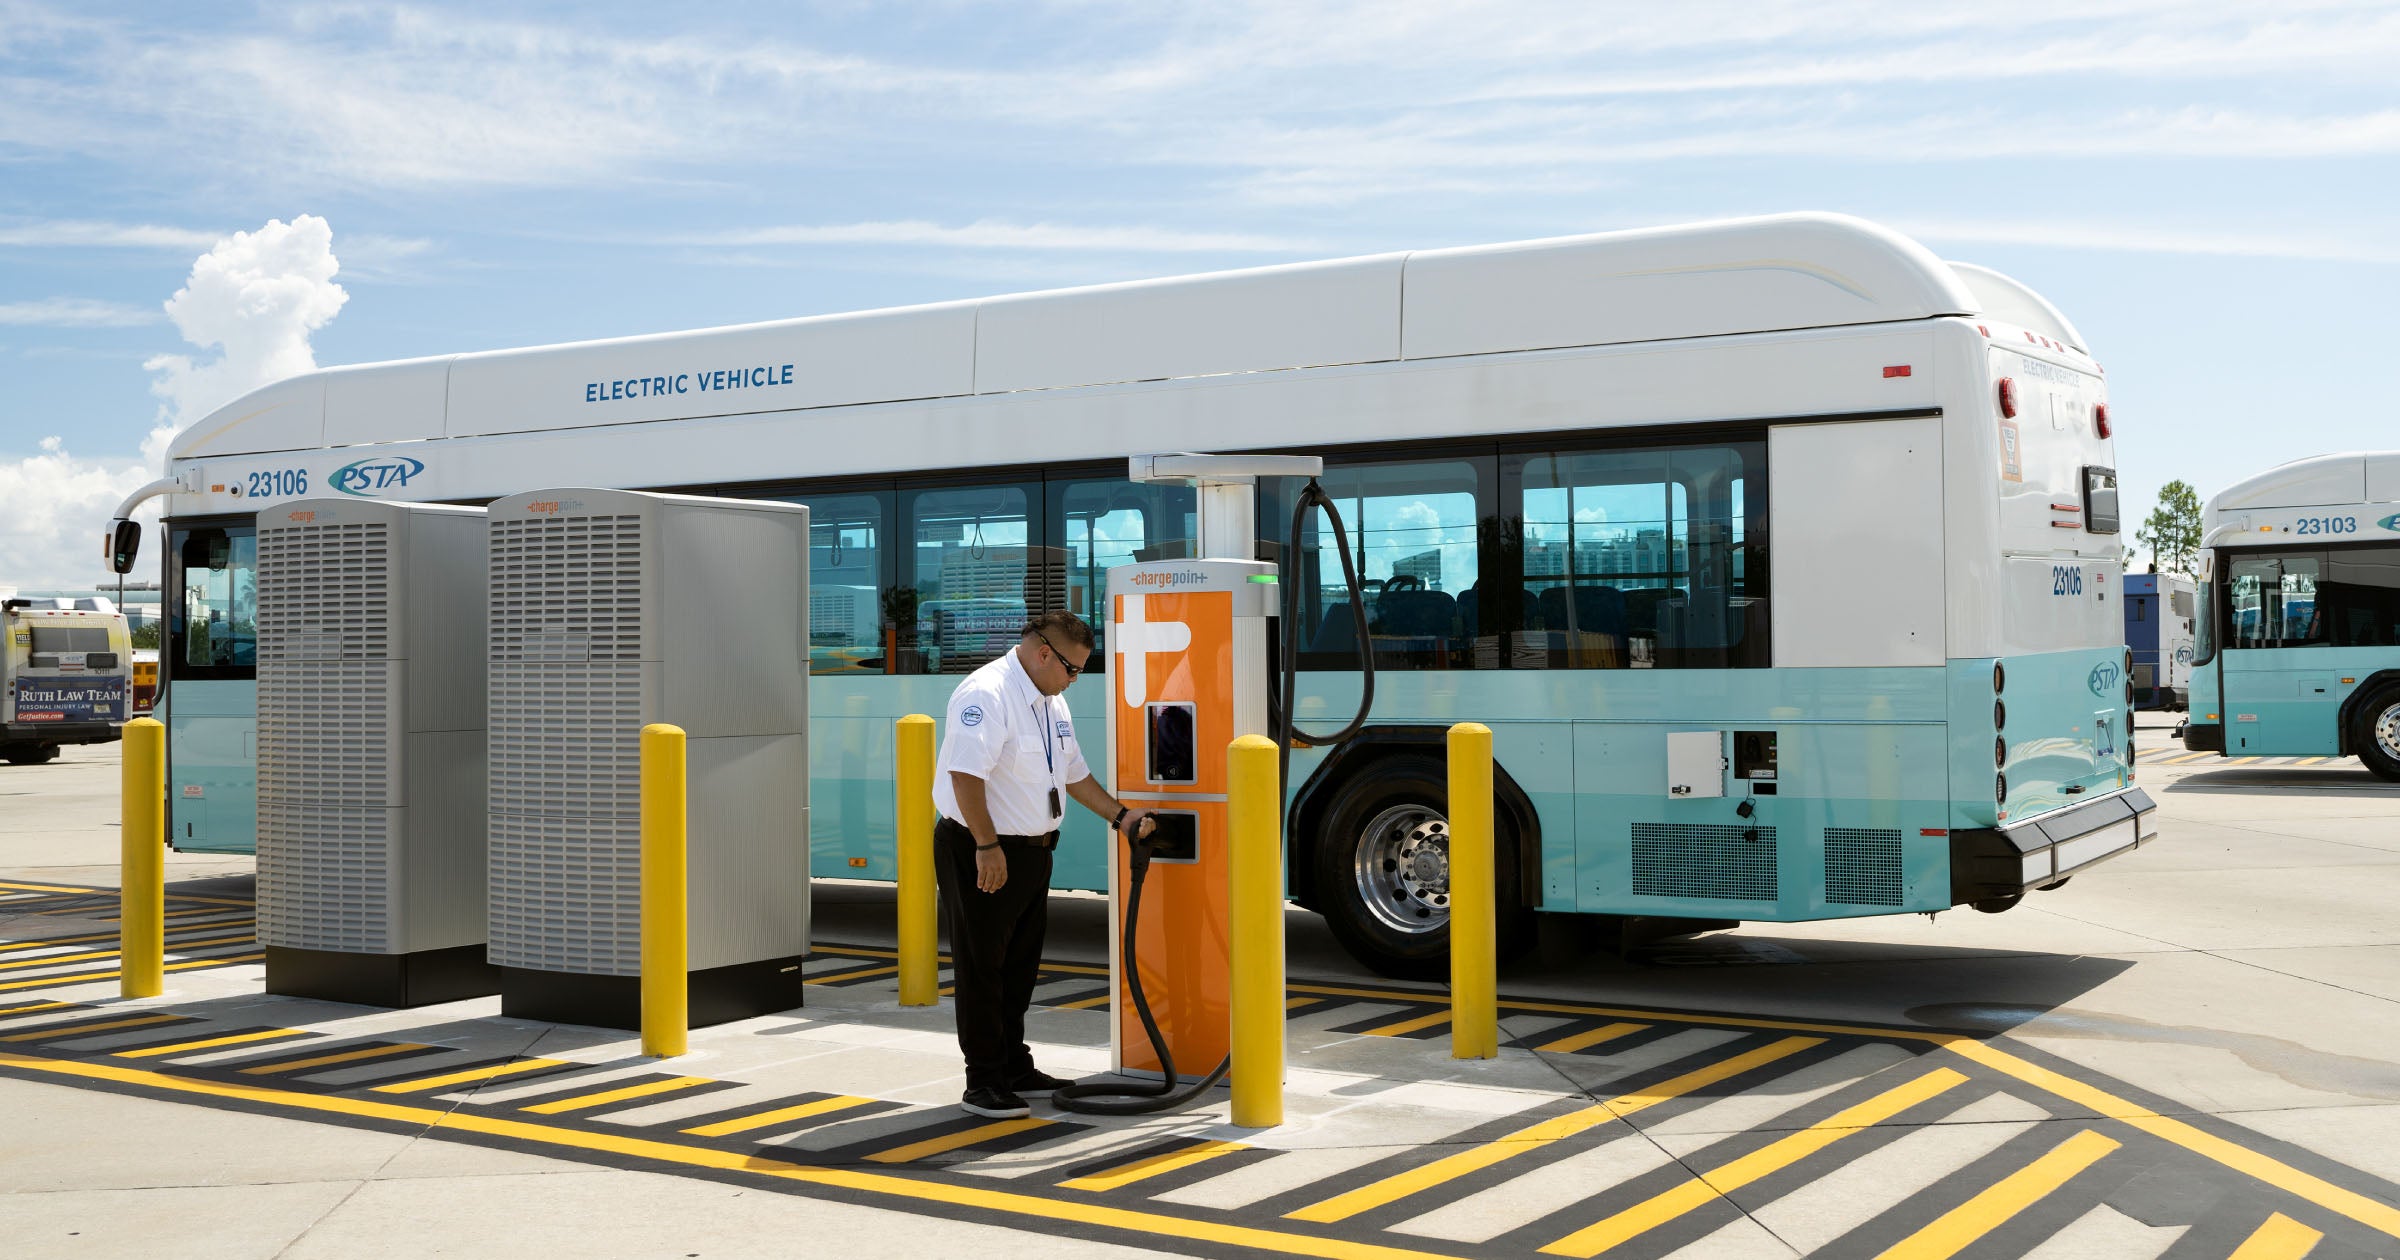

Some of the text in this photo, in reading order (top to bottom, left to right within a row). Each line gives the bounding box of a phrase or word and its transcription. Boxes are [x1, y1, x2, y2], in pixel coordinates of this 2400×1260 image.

[586, 364, 794, 402] ELECTRIC VEHICLE
[248, 462, 409, 497] 23106 PSTA
[2297, 517, 2357, 534] 23103
[2053, 565, 2082, 596] 23106
[2090, 666, 2116, 692] PSTA
[20, 689, 121, 702] RUTH LAW TEAM
